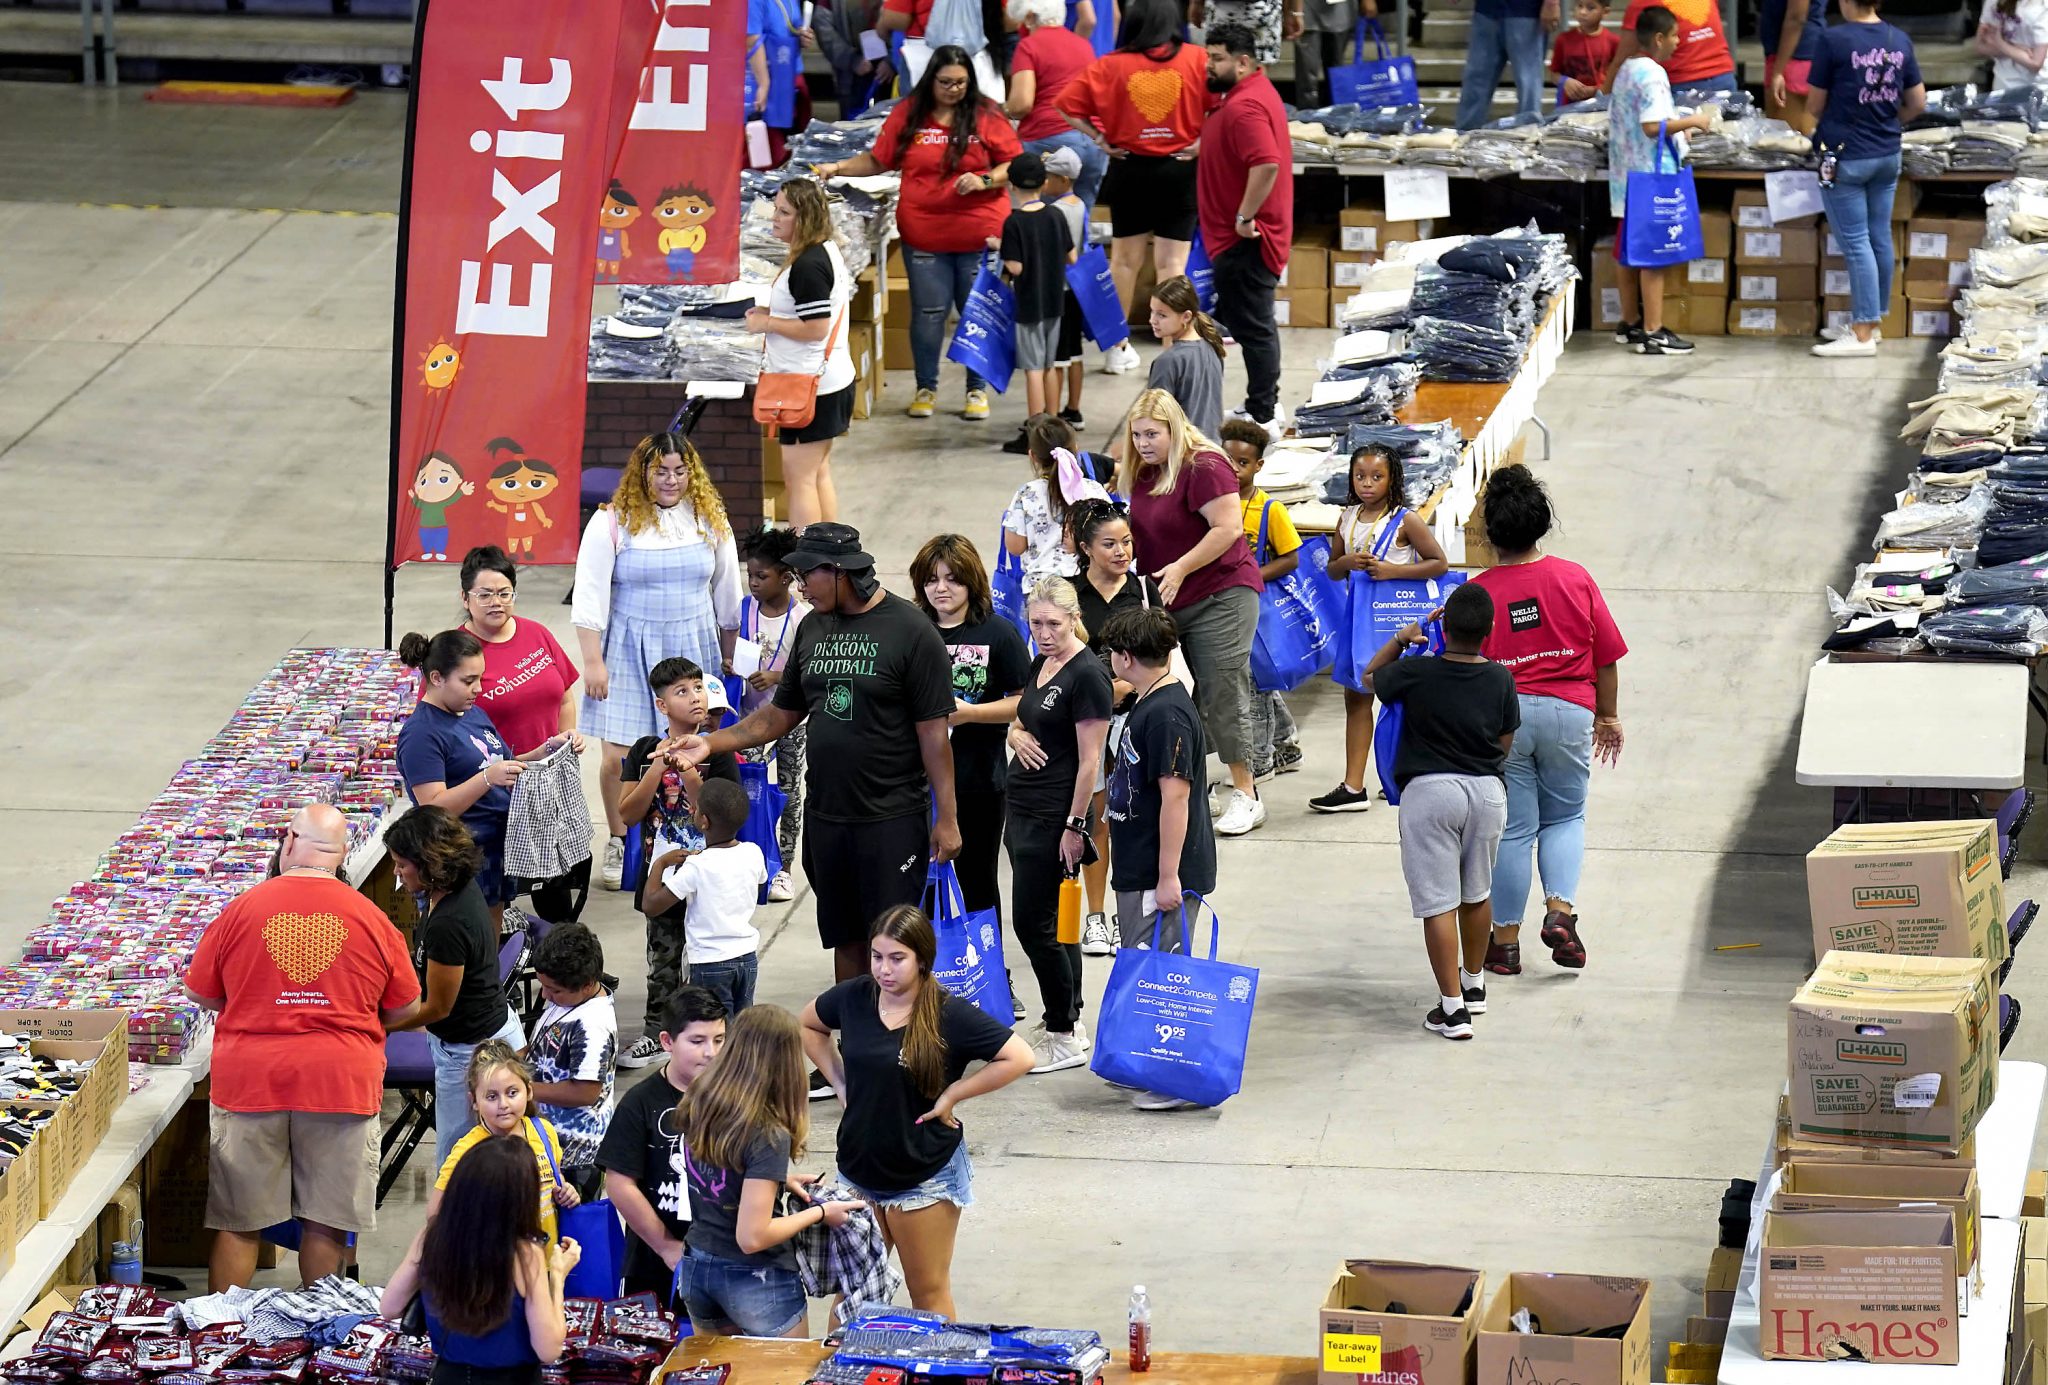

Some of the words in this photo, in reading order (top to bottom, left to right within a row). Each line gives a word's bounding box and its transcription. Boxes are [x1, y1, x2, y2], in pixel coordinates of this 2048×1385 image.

[455, 56, 573, 337] Exit
[1395, 590, 1416, 599] COX
[1511, 606, 1538, 617] WELLS
[1512, 613, 1539, 624] FARGO
[813, 641, 879, 657] DRAGONS
[514, 657, 531, 670] Wells
[529, 647, 545, 660] Fargo
[1517, 653, 1538, 663] better
[1539, 650, 1560, 658] every
[807, 659, 877, 676] FOOTBALL
[1857, 888, 1915, 901] U-HAUL
[1835, 925, 1877, 941] SAVE!
[1167, 973, 1192, 985] COX
[310, 998, 331, 1006] Fargo.
[1136, 996, 1167, 1008] Low-Cost,
[1168, 1002, 1187, 1011] Home
[1188, 1005, 1213, 1015] Internet
[1841, 1042, 1903, 1057] U-HAUL
[1816, 1079, 1859, 1090] SAVE!
[1816, 1095, 1835, 1103] BEST
[1836, 1094, 1859, 1102] PRICE
[1818, 1103, 1866, 1112] GUARANTEED
[1327, 1340, 1377, 1353] Tear-away
[1338, 1354, 1366, 1364] Label
